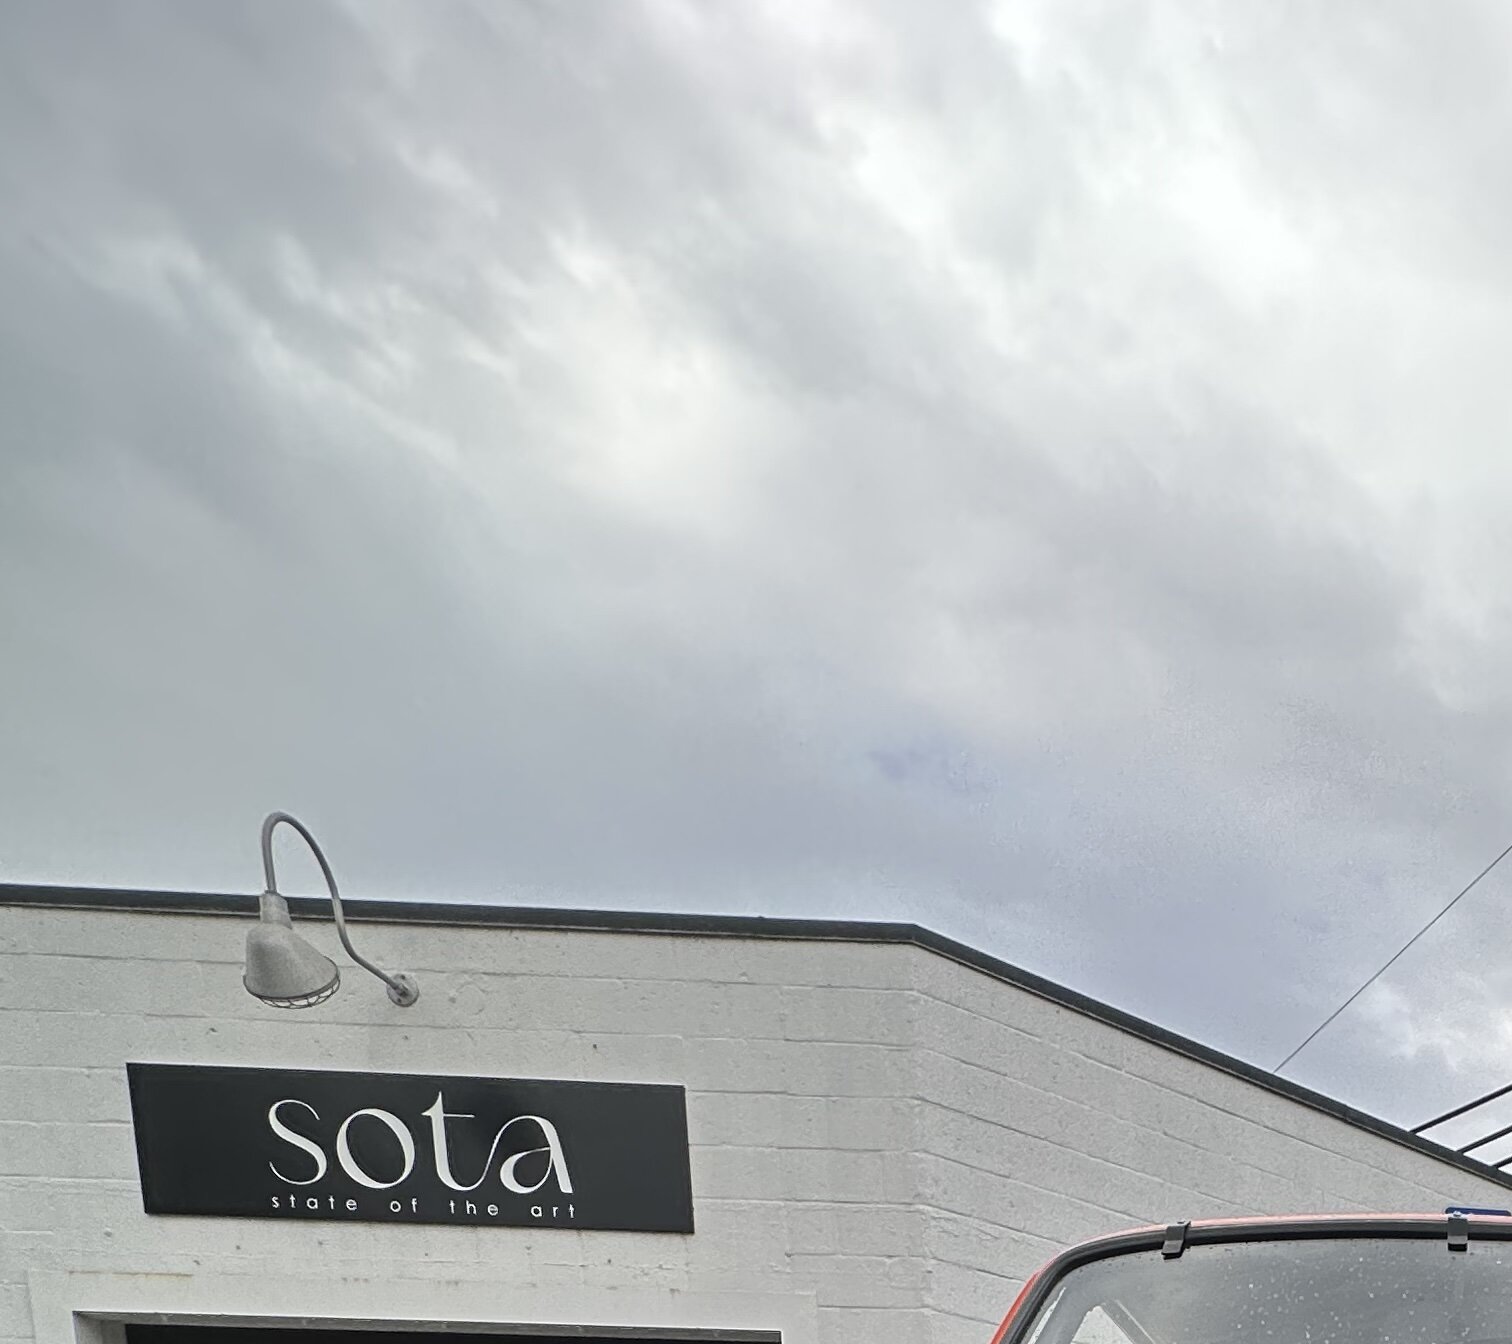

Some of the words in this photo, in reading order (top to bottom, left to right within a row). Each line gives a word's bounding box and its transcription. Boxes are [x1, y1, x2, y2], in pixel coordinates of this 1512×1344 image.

[268, 1091, 573, 1194] sota
[271, 1194, 358, 1211] state
[390, 1198, 419, 1213] of
[449, 1200, 499, 1216] the
[531, 1203, 576, 1219] art
